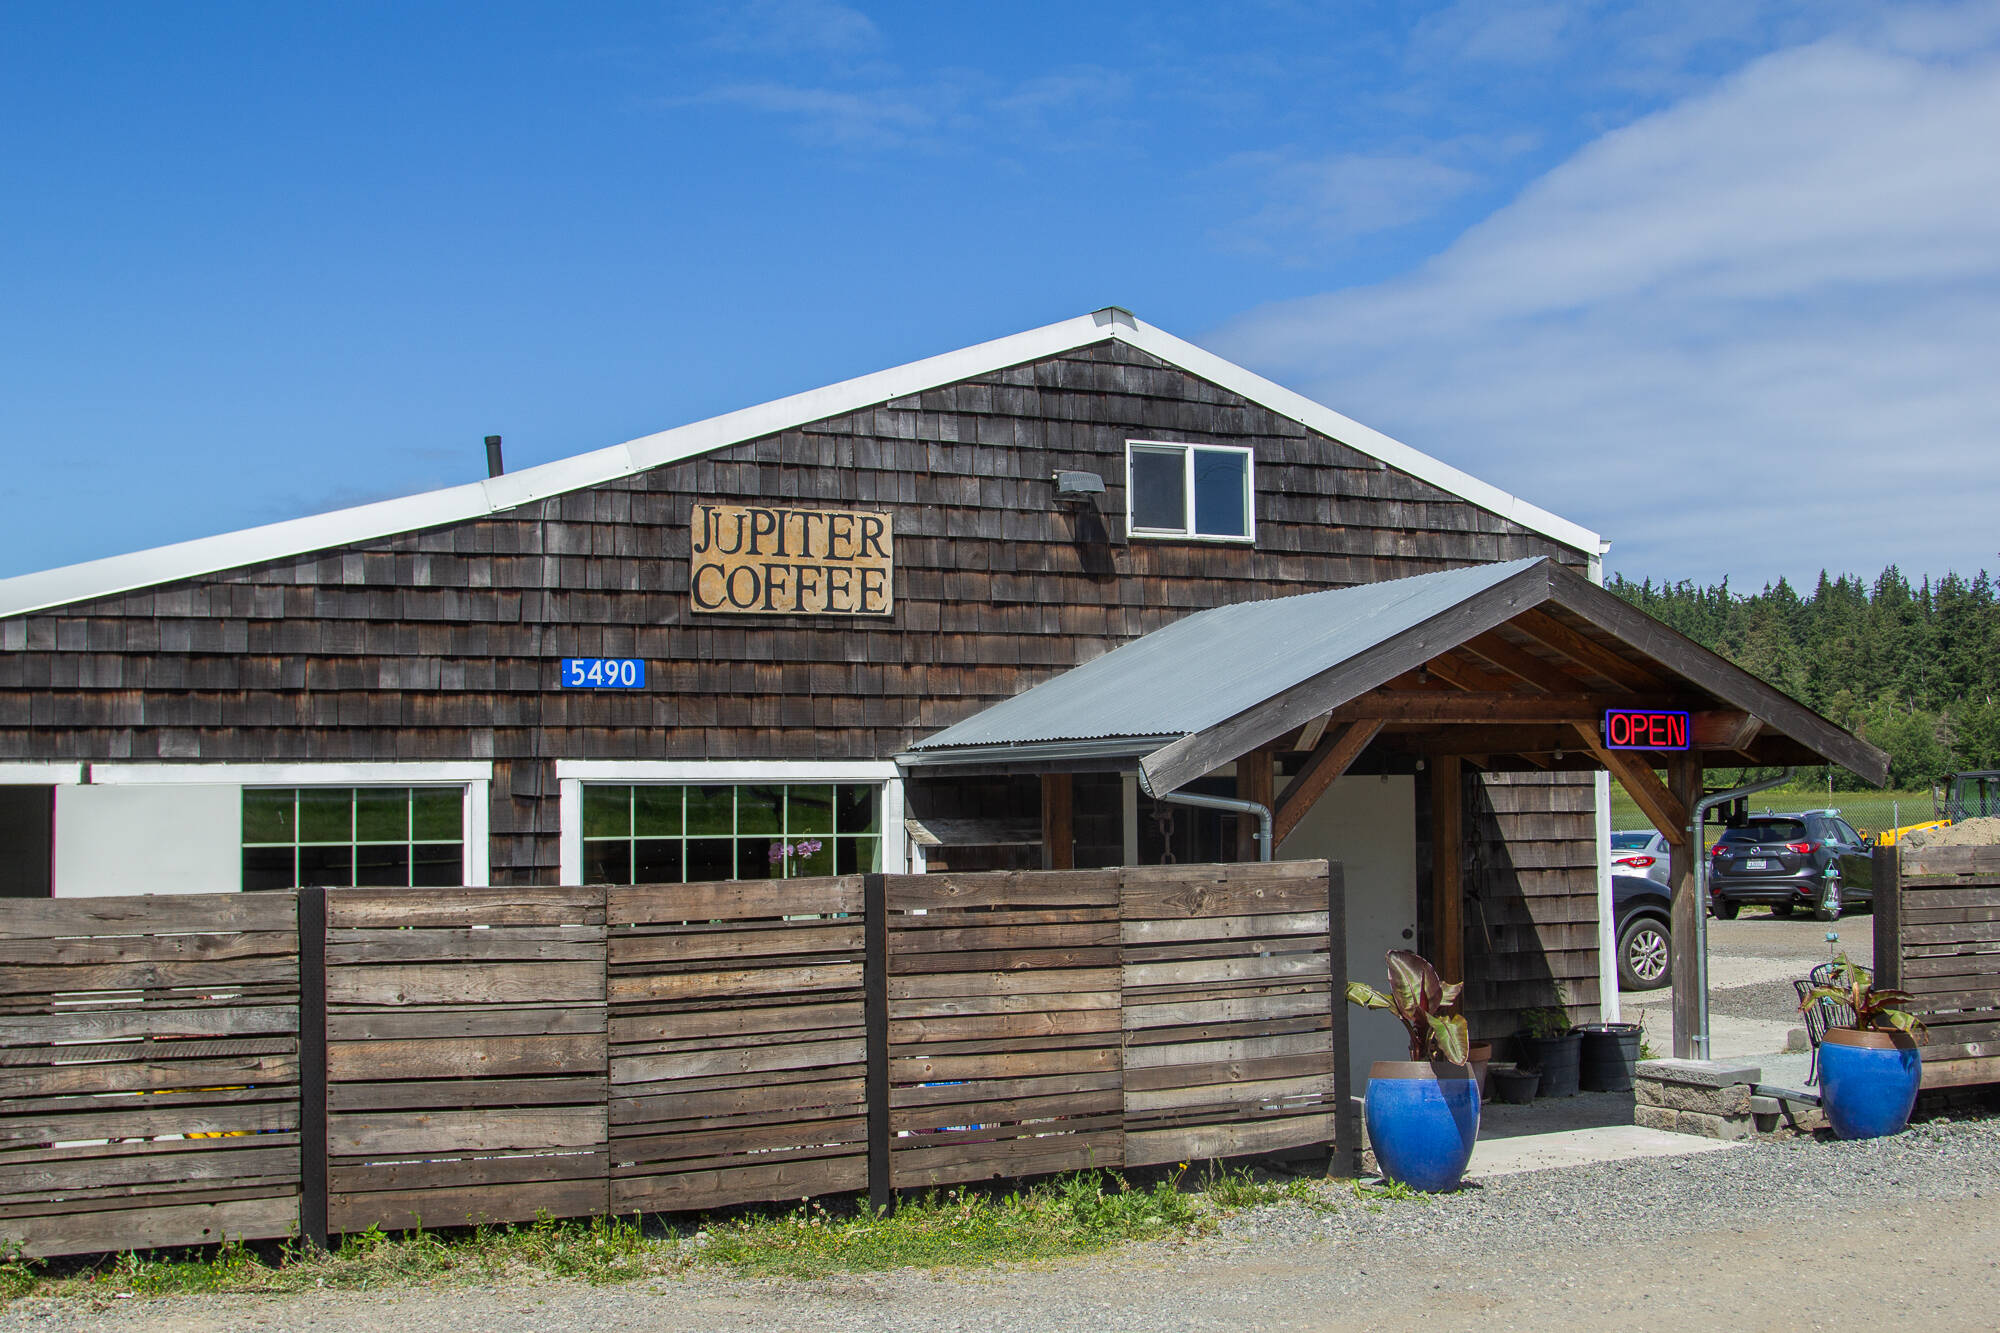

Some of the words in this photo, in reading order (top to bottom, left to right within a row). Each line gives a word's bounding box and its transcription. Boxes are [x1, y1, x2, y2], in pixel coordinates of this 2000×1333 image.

[693, 506, 890, 561] JUPITER
[692, 563, 888, 614] COFFEE
[571, 660, 636, 686] 5490
[1611, 714, 1685, 746] OPEN
